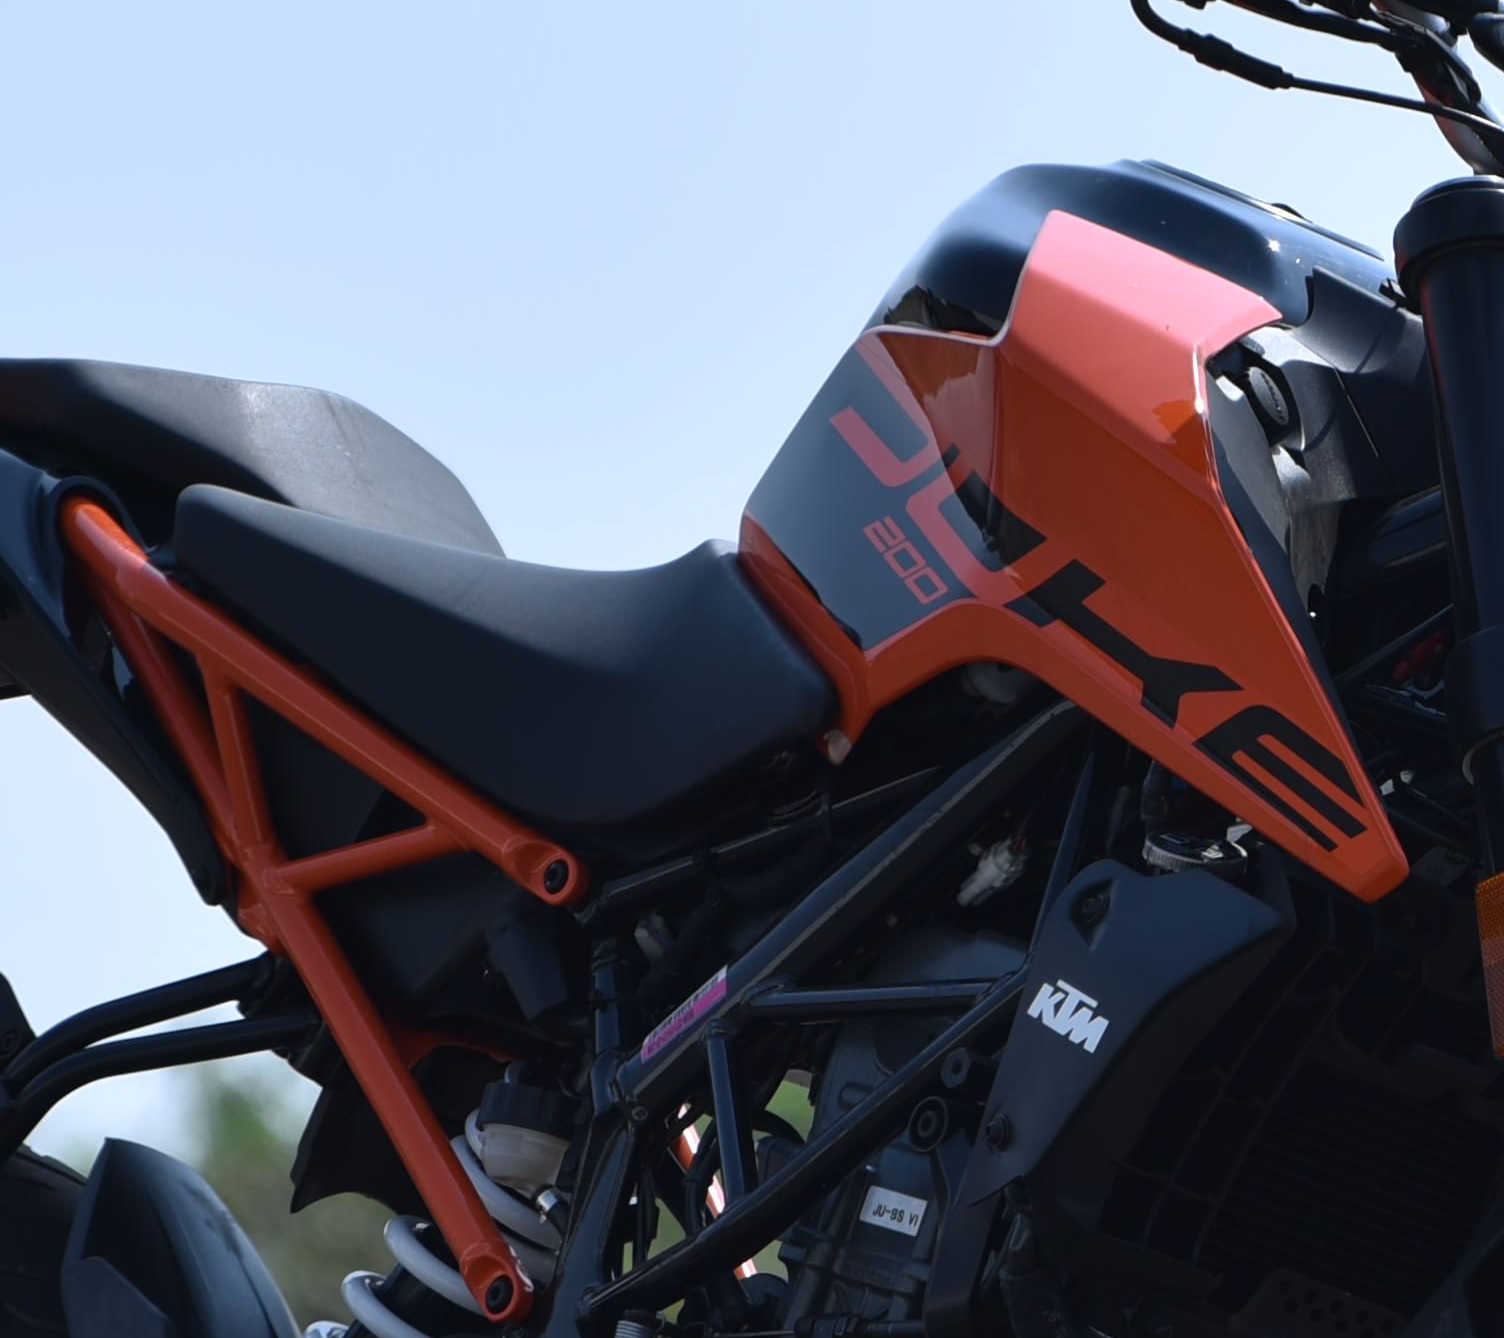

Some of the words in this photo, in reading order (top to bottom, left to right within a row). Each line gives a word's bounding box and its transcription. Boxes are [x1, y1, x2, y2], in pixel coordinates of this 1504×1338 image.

[829, 335, 1368, 852] DUKE
[862, 516, 948, 604] 200
[1027, 980, 1109, 1053] KTM
